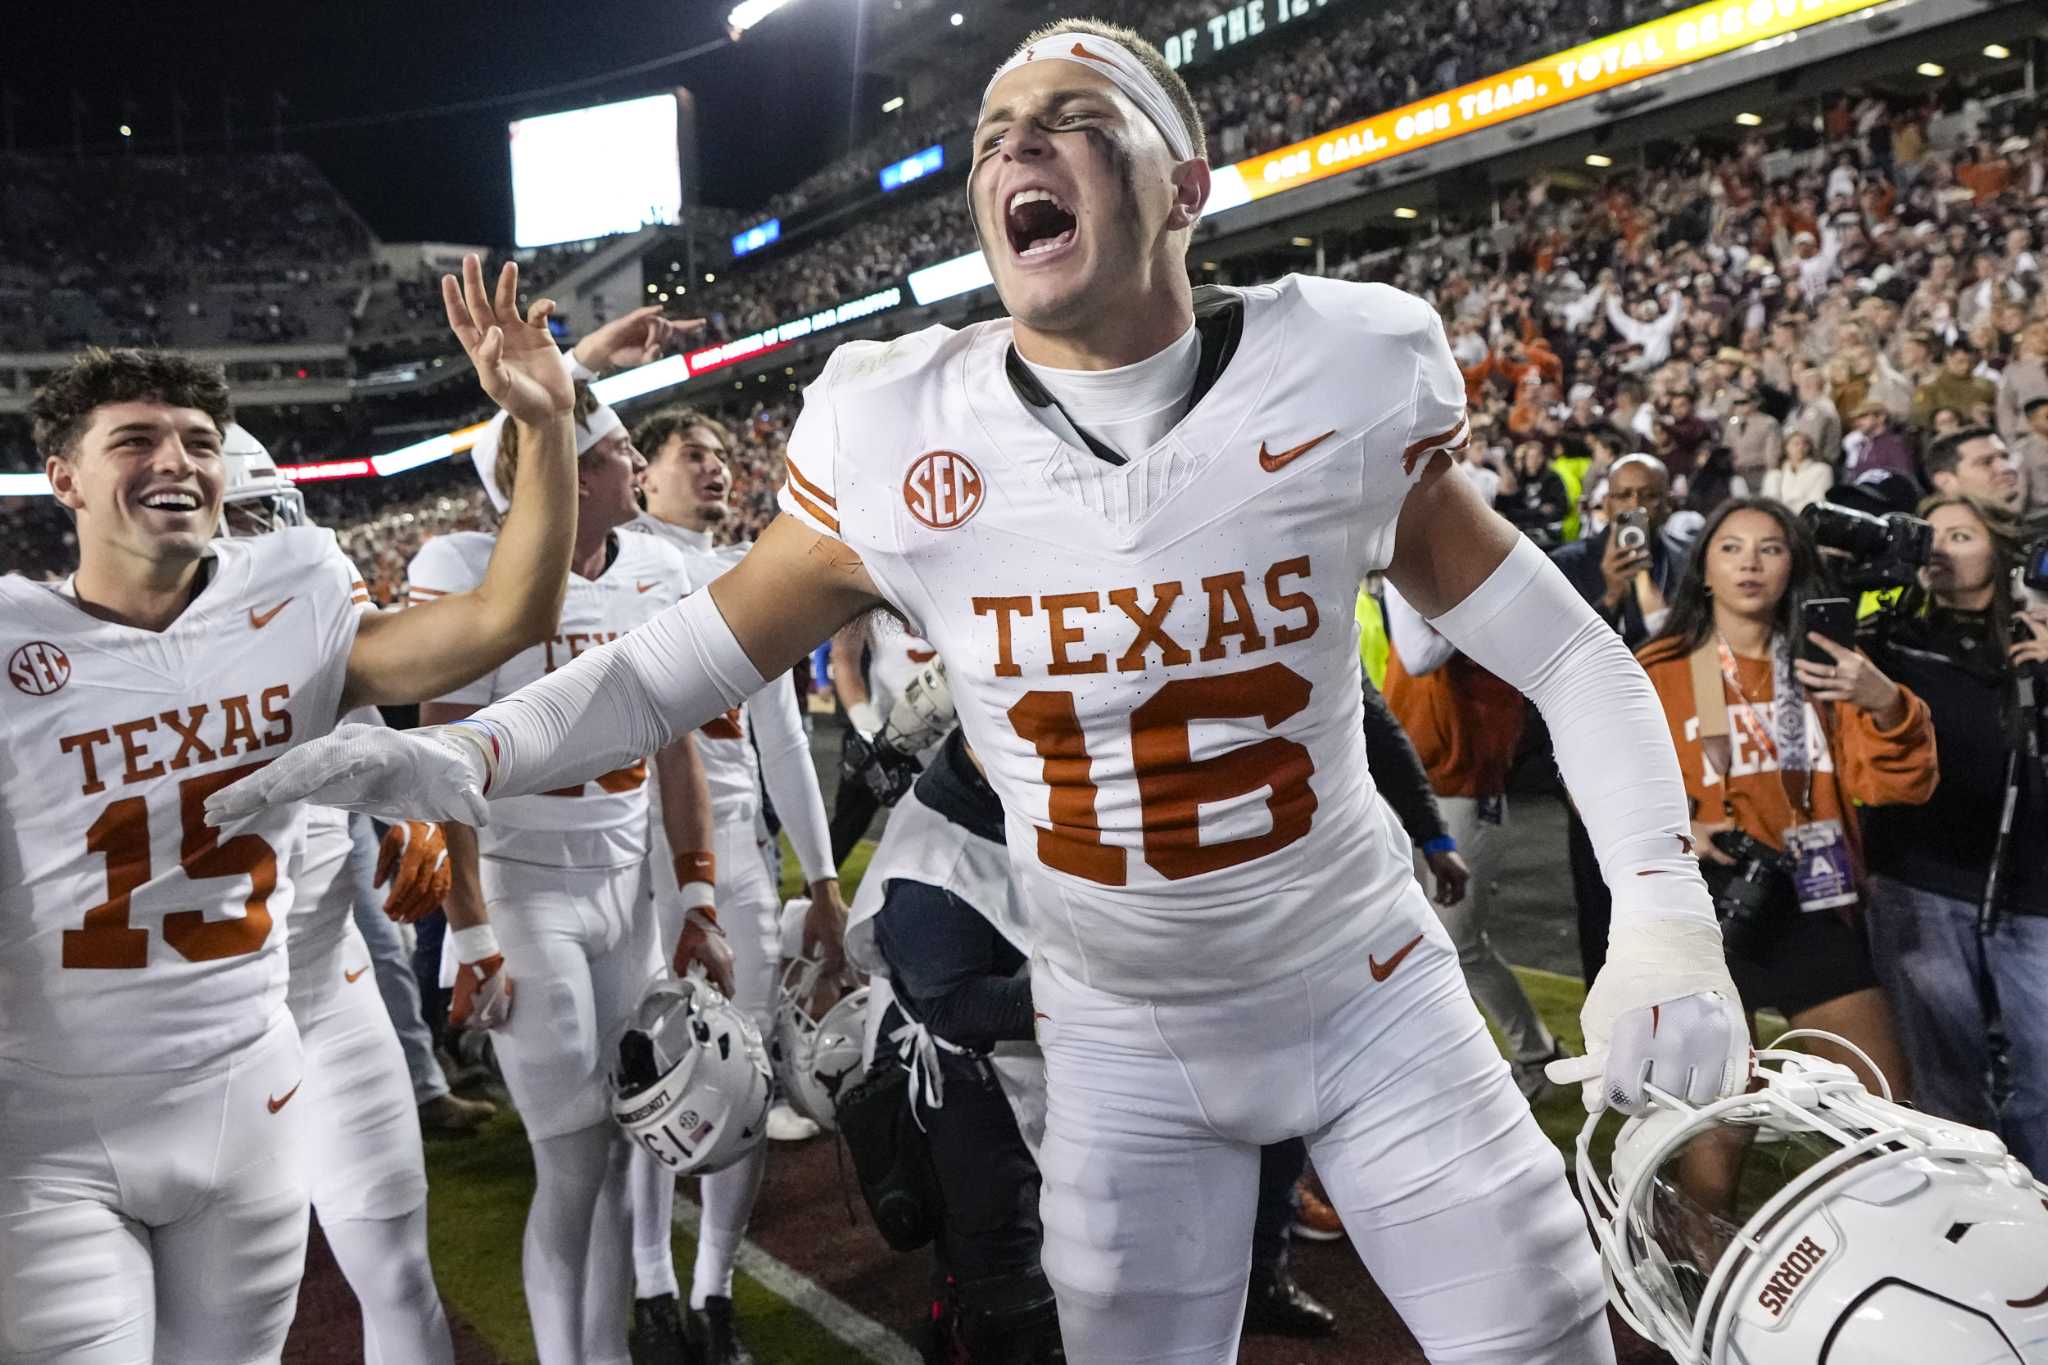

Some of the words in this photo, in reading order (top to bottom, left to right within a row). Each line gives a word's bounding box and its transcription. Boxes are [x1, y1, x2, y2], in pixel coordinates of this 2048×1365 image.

[1165, 28, 1197, 69] OF
[1207, 0, 1265, 50] THE
[1395, 104, 1450, 140] ONE
[1558, 34, 1664, 89] TOTAL
[1677, 0, 1840, 50] RECOV
[908, 454, 979, 525] SEC
[9, 642, 70, 694] SEC
[971, 554, 1320, 678] TEXAS
[59, 684, 293, 795] TEXAS
[1007, 661, 1319, 886] 16
[62, 757, 282, 969] 15
[1758, 1236, 1827, 1316] HORNS
